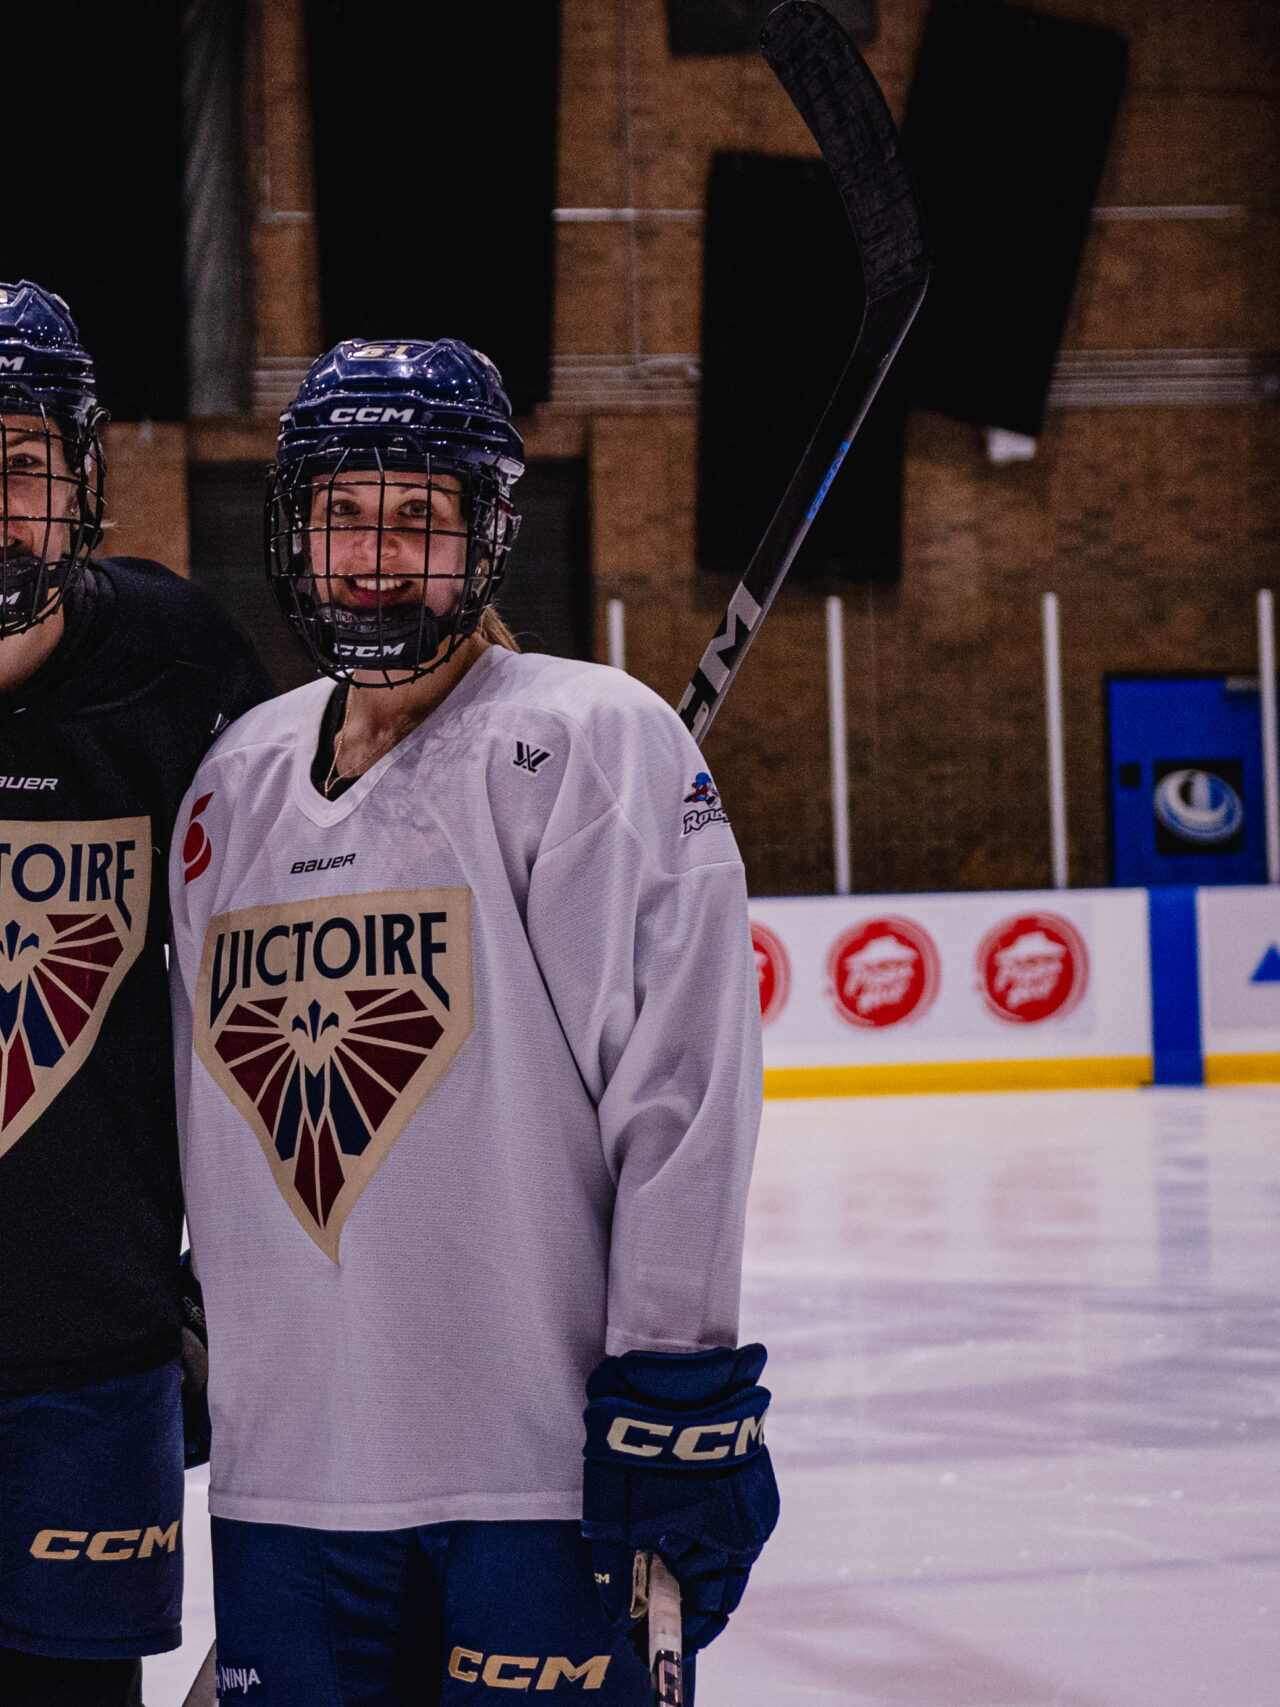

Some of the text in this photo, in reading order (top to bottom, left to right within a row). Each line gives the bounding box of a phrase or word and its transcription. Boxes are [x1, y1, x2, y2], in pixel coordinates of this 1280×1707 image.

[330, 407, 415, 423] CCM
[333, 642, 406, 658] CCM
[290, 853, 356, 874] BAUER
[210, 911, 450, 1030] VICTOIRE
[606, 1408, 768, 1461] CCM
[29, 1520, 180, 1561] CCM
[448, 1646, 612, 1690] CCM
